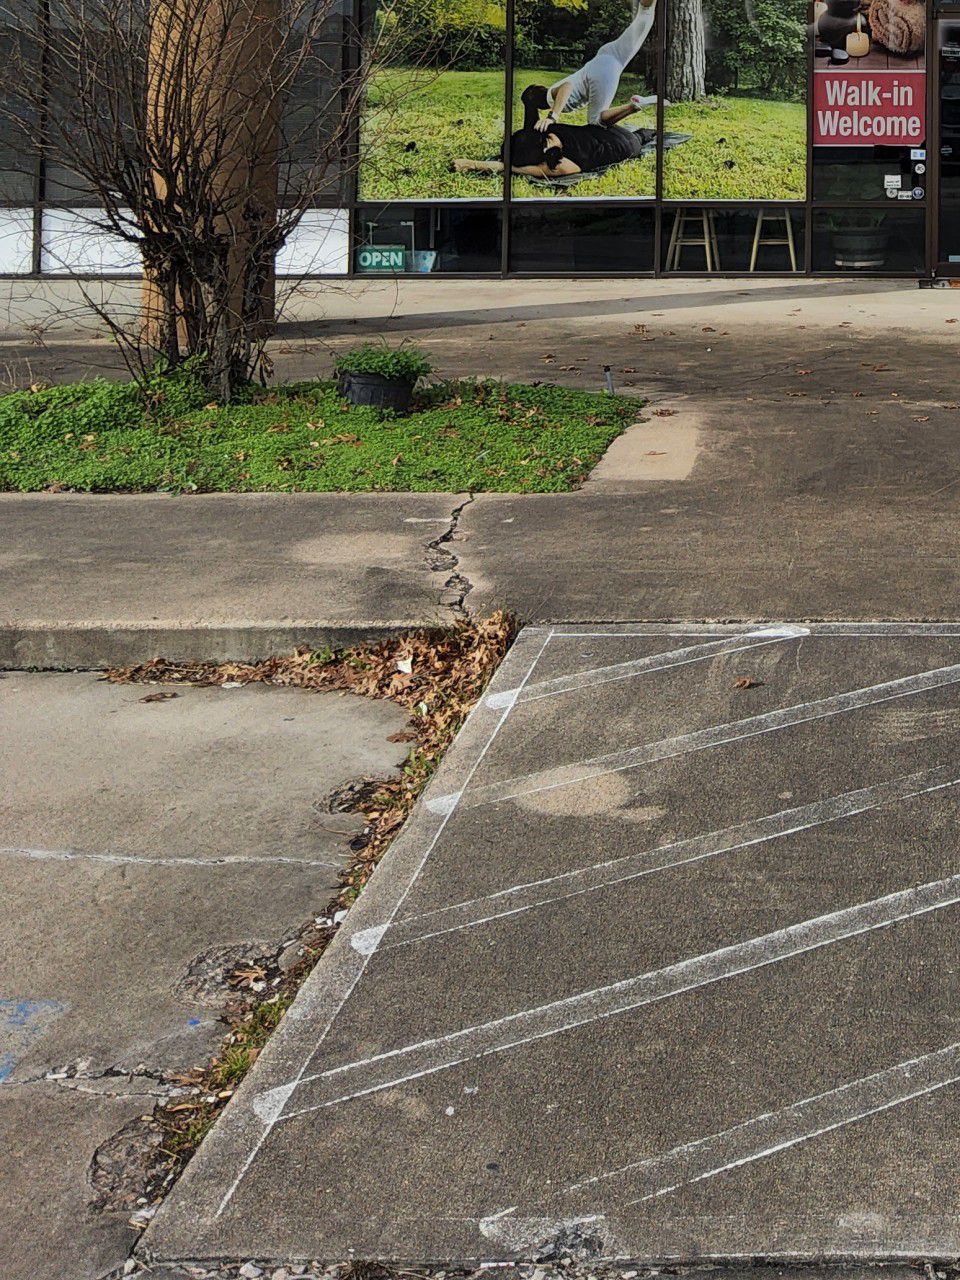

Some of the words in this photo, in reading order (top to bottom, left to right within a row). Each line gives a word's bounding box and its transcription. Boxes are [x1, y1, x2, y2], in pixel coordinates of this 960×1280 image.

[825, 80, 913, 106] Walk-in
[817, 110, 921, 137] Welcome
[358, 251, 403, 267] OPEN
